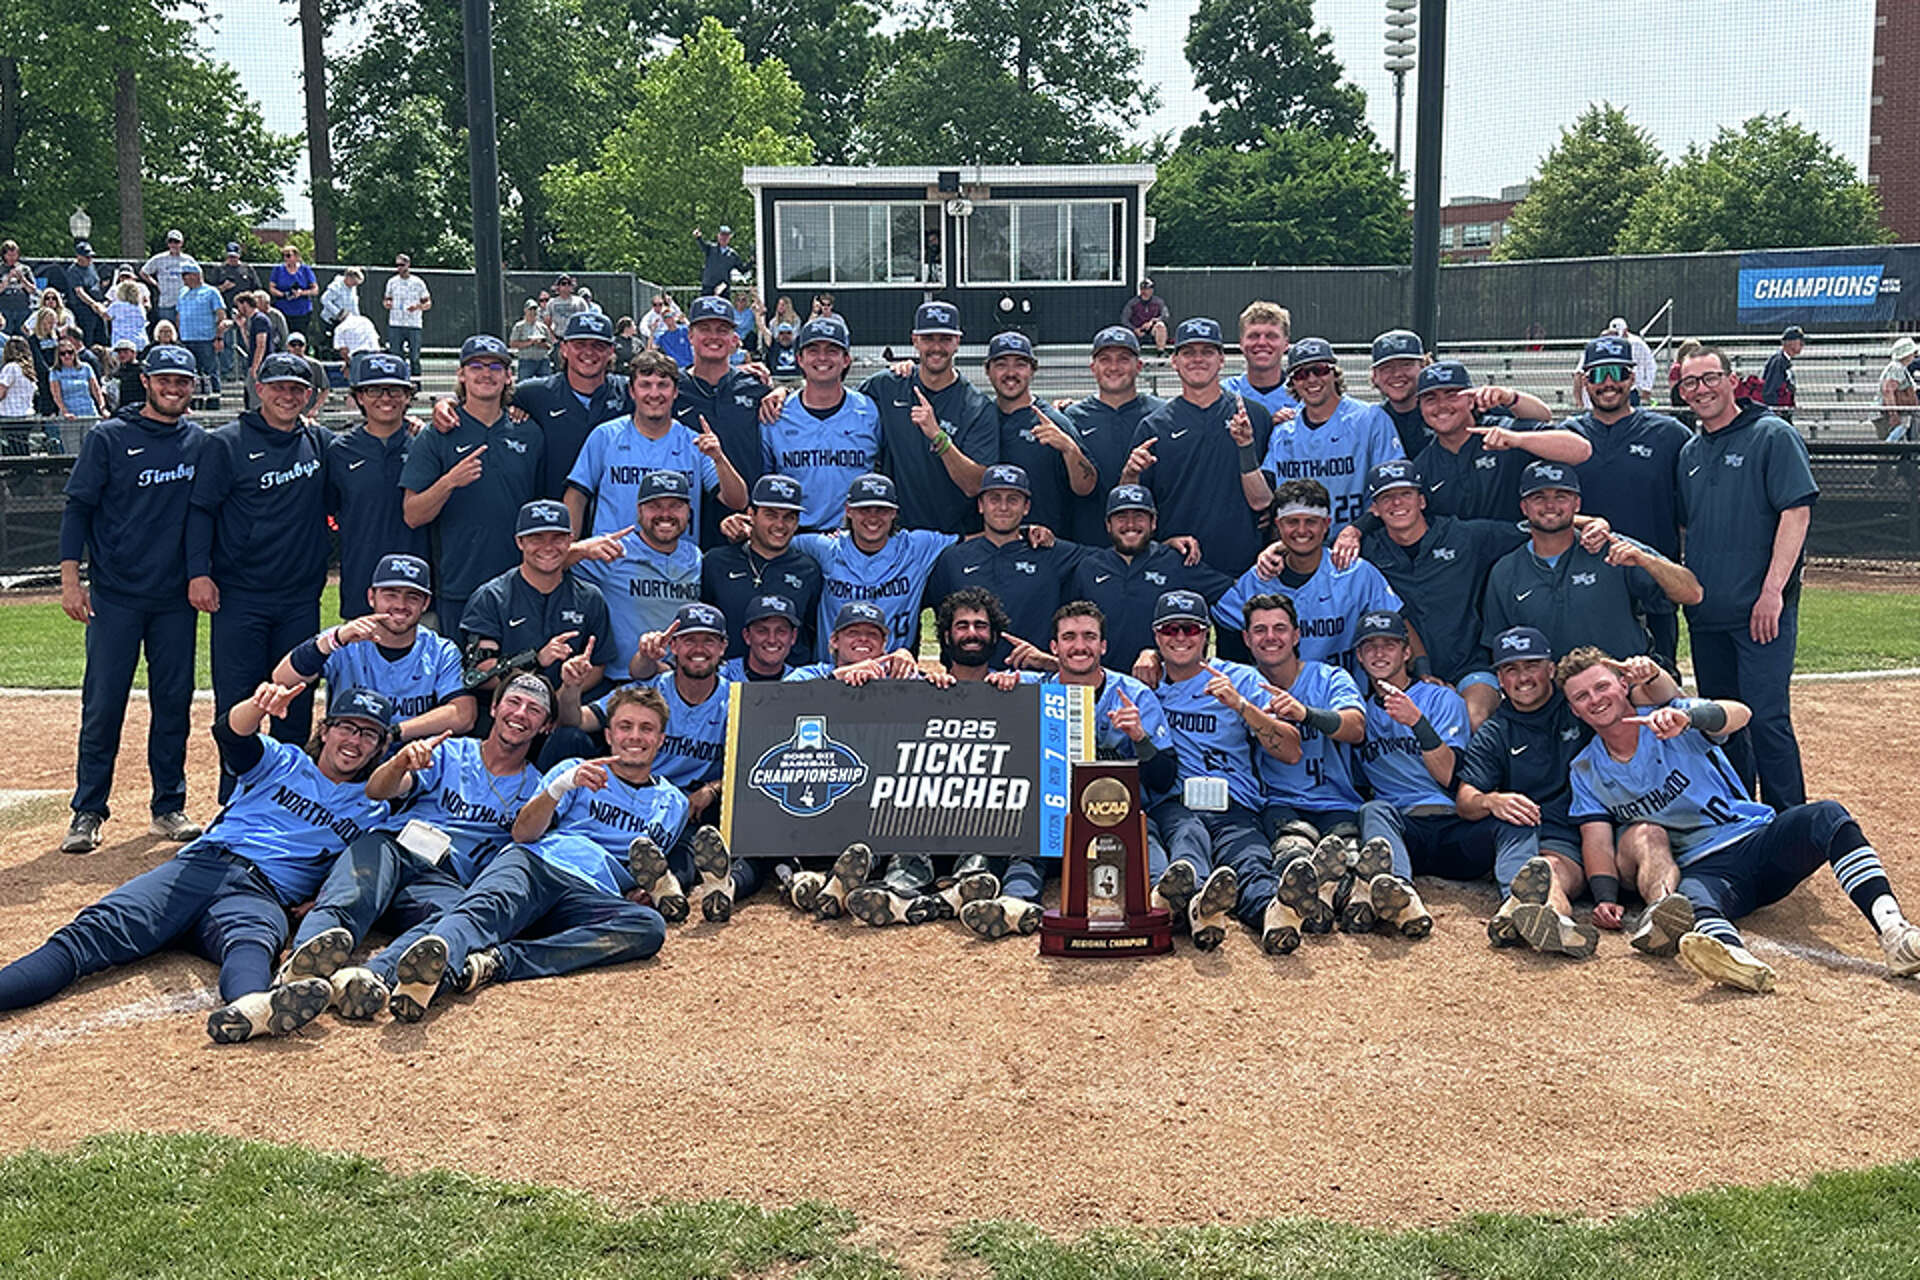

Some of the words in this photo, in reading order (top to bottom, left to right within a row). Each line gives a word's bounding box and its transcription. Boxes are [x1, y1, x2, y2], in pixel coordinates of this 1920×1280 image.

[1754, 276, 1879, 299] CHAMPIONS
[782, 449, 865, 468] NORTHWOOD
[1277, 456, 1354, 478] NORTHWOOD
[138, 463, 195, 487] Timby
[260, 459, 320, 489] Timbys
[1335, 494, 1363, 523] 22
[828, 576, 910, 600] NORTHWOOD
[1044, 693, 1065, 720] 25
[925, 718, 997, 739] 2025
[896, 742, 1011, 775] TICKET
[1045, 748, 1066, 762] 7
[753, 766, 864, 784] CHAMPIONSHIP
[870, 776, 1031, 810] PUNCHED
[1044, 793, 1065, 808] 6
[1088, 801, 1129, 816] NCAA
[1109, 938, 1148, 948] CHAMPION
